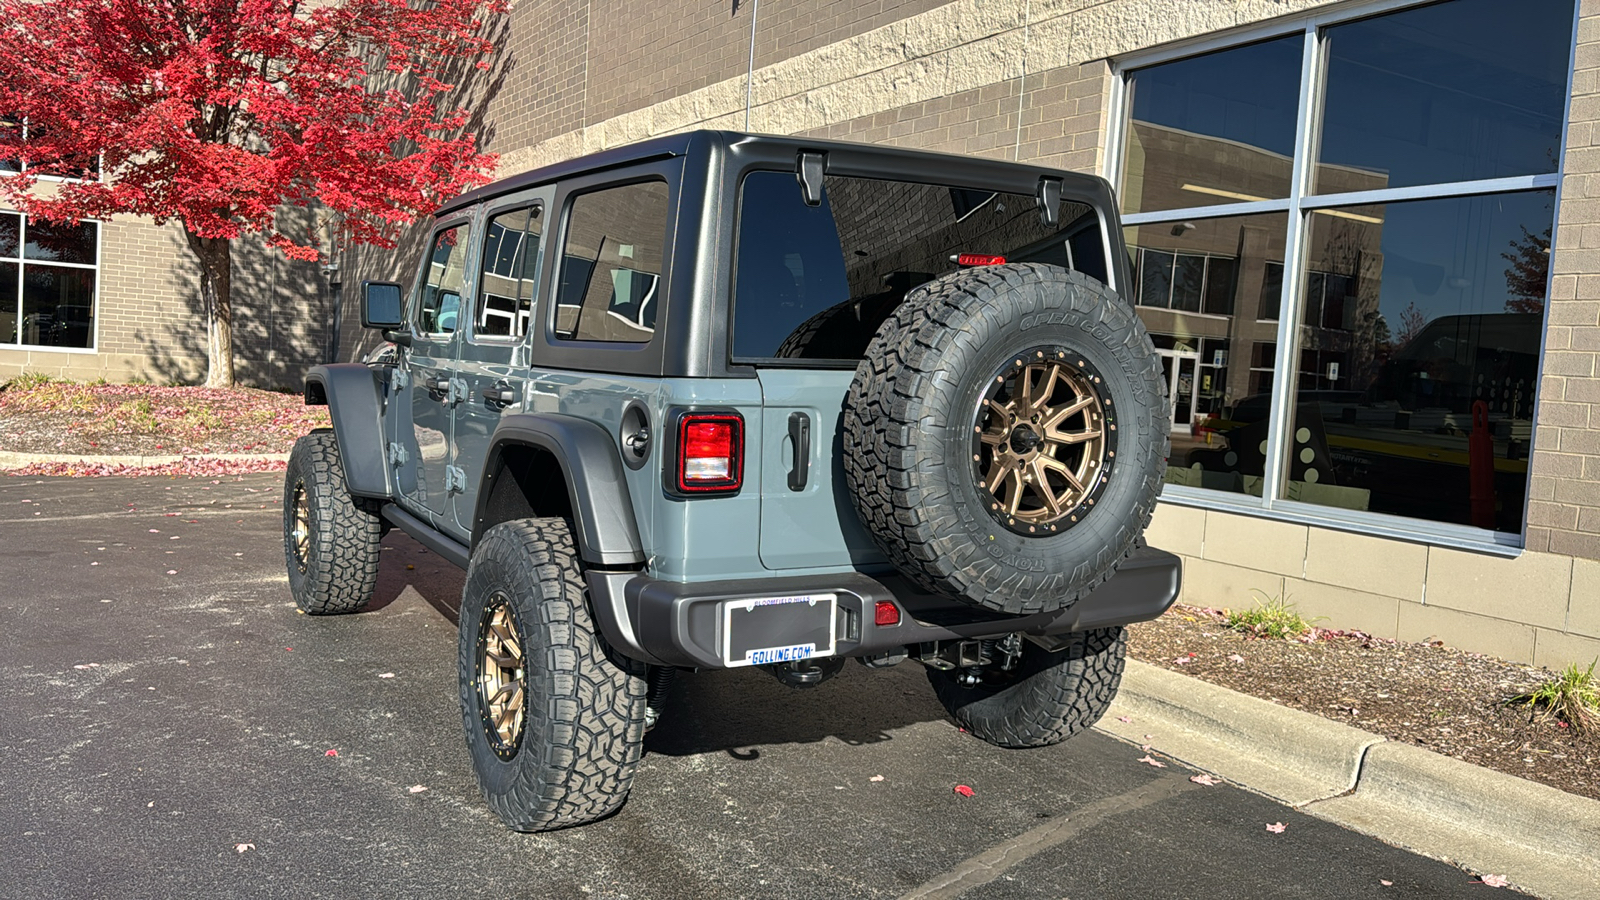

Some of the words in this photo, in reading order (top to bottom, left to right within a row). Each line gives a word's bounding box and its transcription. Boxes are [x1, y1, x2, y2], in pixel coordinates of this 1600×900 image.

[1020, 312, 1080, 332] OPEN
[1080, 319, 1148, 407] COUNTRY
[987, 544, 1046, 572] TOYO
[752, 646, 811, 664] GOLLING.COM
